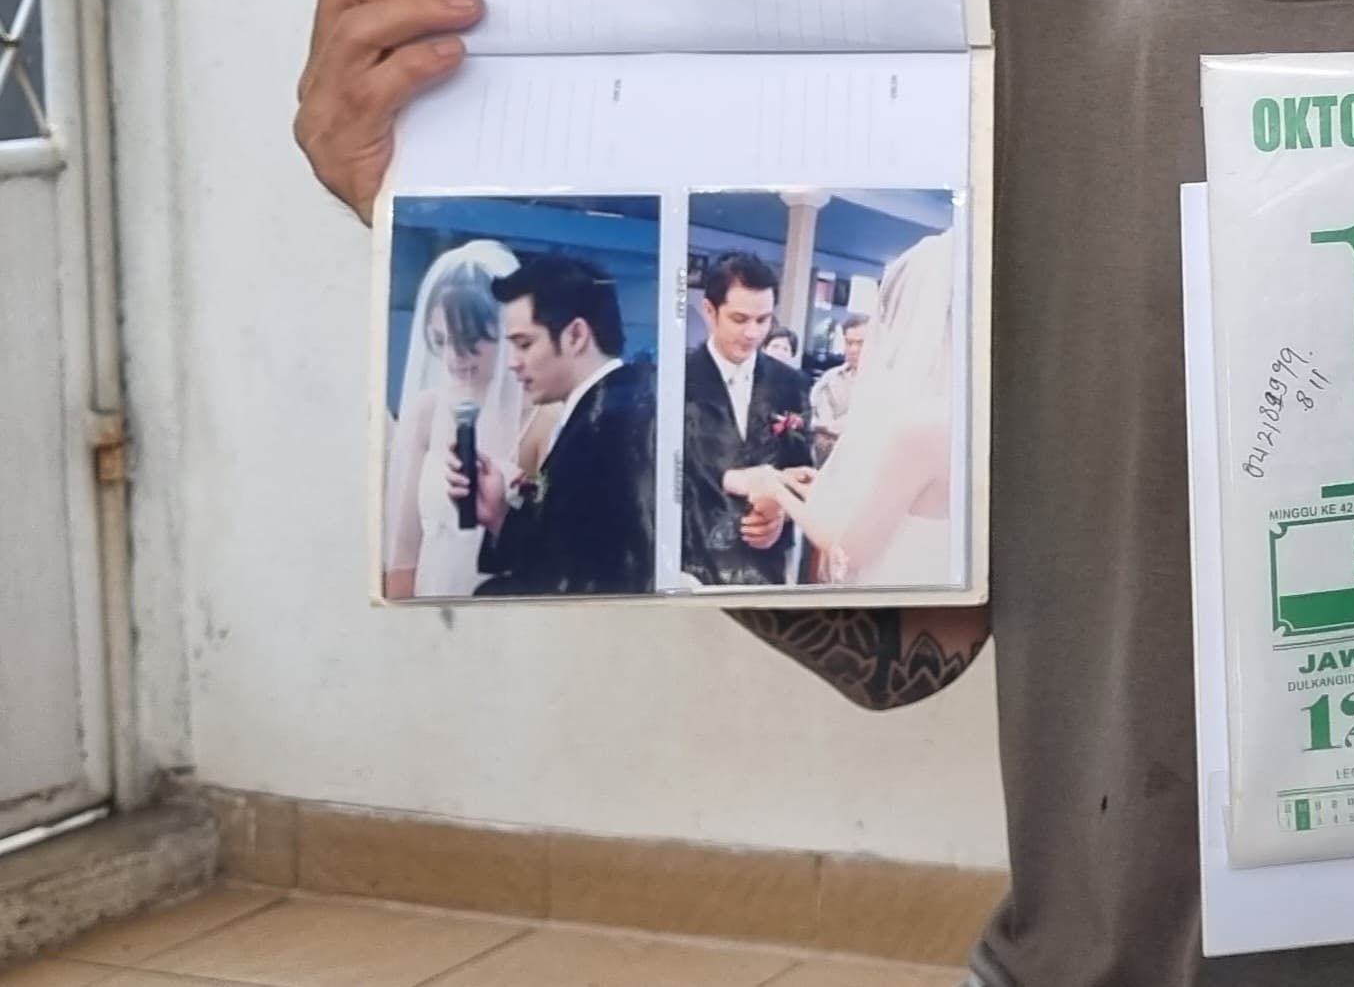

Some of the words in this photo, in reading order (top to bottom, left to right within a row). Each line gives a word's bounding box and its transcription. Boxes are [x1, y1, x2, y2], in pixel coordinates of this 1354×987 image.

[1268, 505, 1318, 520] MINGGU
[1321, 503, 1337, 516] KE
[1340, 501, 1354, 513] 42
